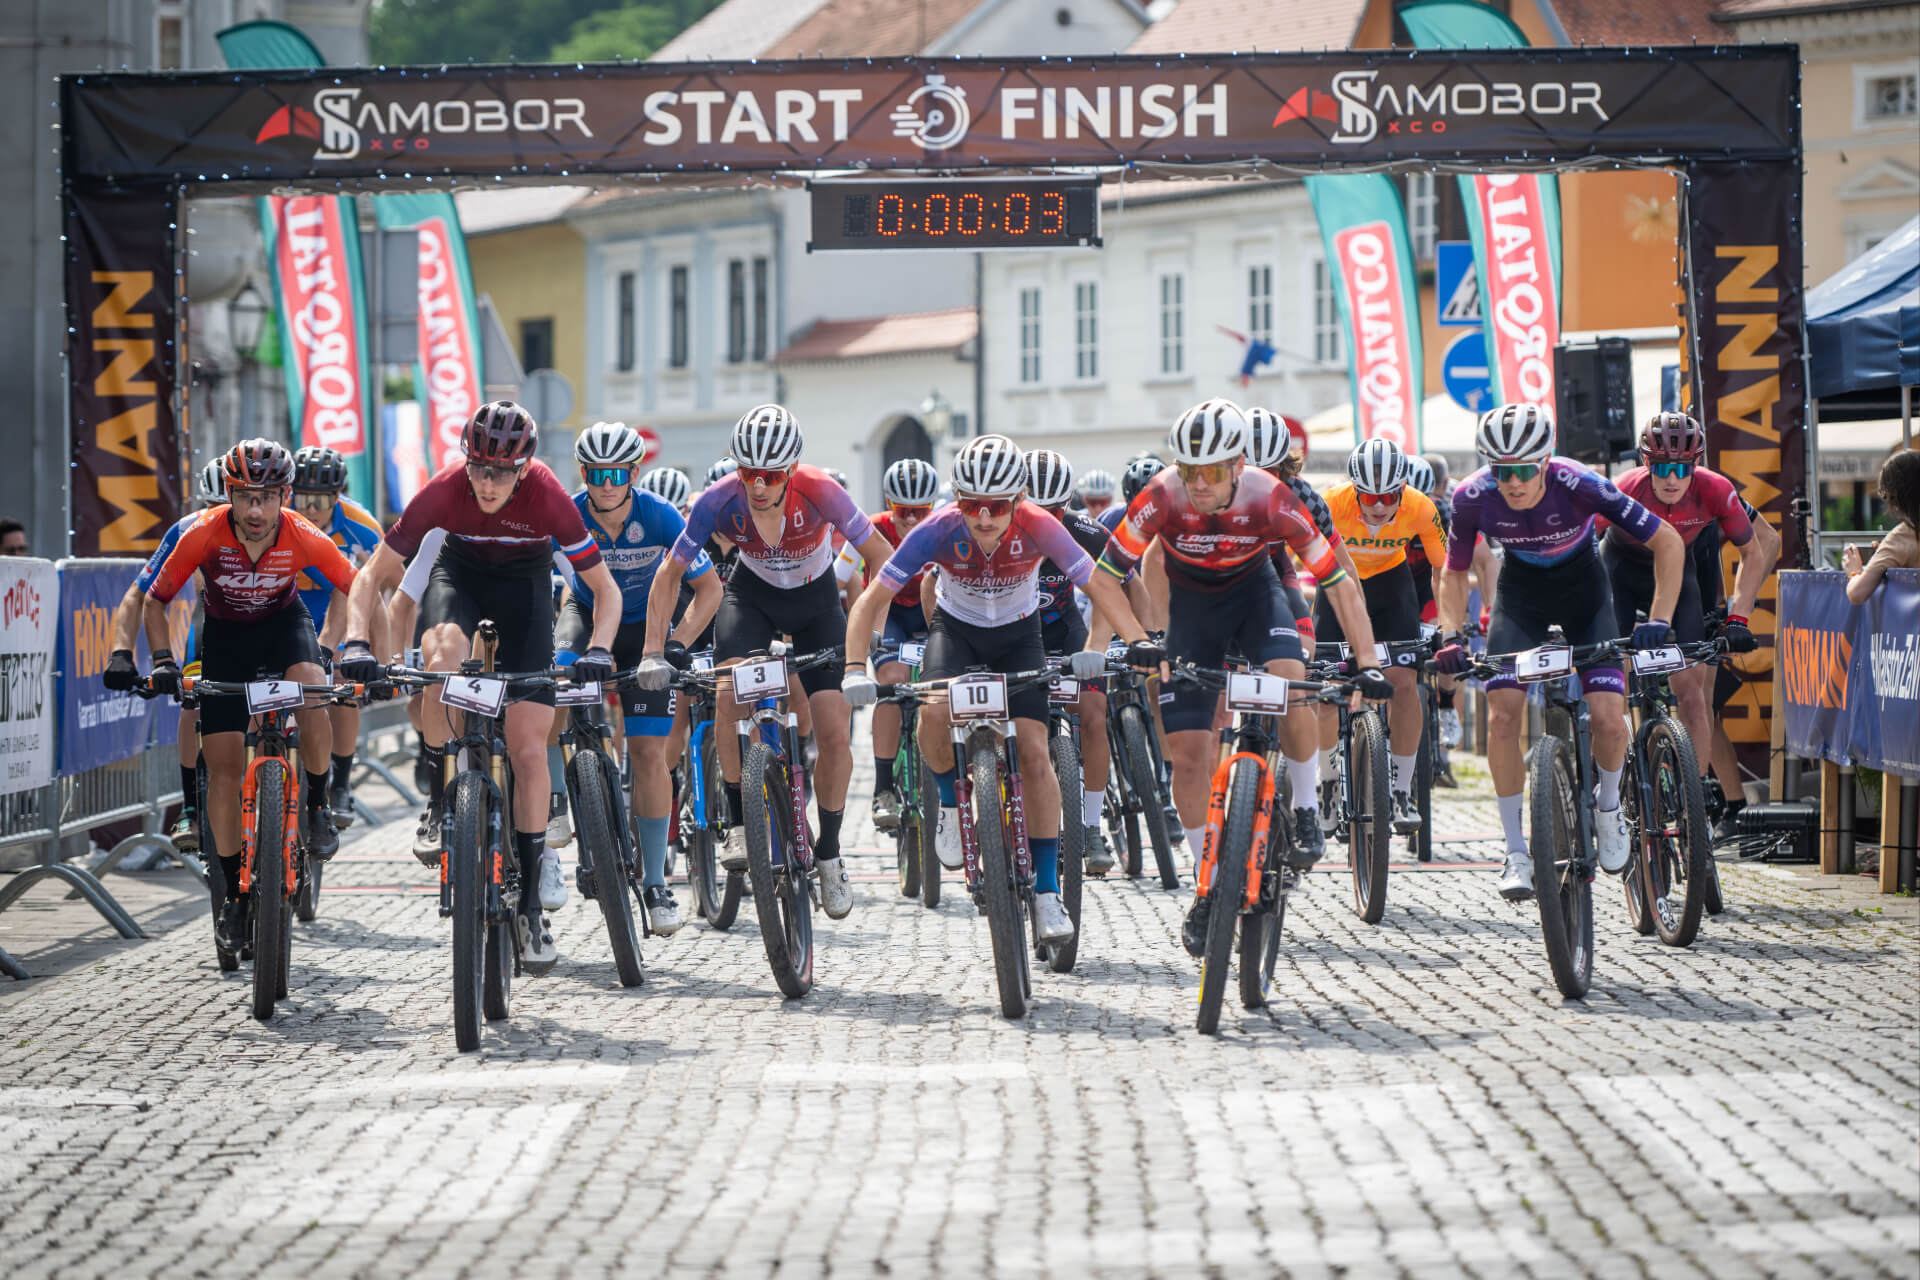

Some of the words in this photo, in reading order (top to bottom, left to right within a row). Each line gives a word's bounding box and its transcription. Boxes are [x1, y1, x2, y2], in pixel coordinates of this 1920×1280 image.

[643, 89, 863, 145] START
[1001, 84, 1228, 142] FINISH
[1330, 70, 1609, 144] SAMOBOR
[313, 88, 593, 160] SAMOBOR
[1387, 120, 1447, 133] XCO
[369, 138, 431, 151] XCO
[876, 192, 1064, 236] 0:00:03
[91, 270, 158, 551] MANN
[1342, 536, 1410, 548] APIRO
[214, 572, 291, 589] KTM
[1538, 654, 1550, 668] 5
[1646, 649, 1667, 660] 14
[753, 666, 765, 684] 3
[268, 682, 280, 695] 2
[467, 679, 482, 694] 4
[966, 685, 988, 705] 10
[1253, 677, 1262, 695] 1
[792, 786, 805, 852] MANITOU
[960, 802, 976, 871] MANITOU
[1011, 796, 1027, 865] MANITOU
